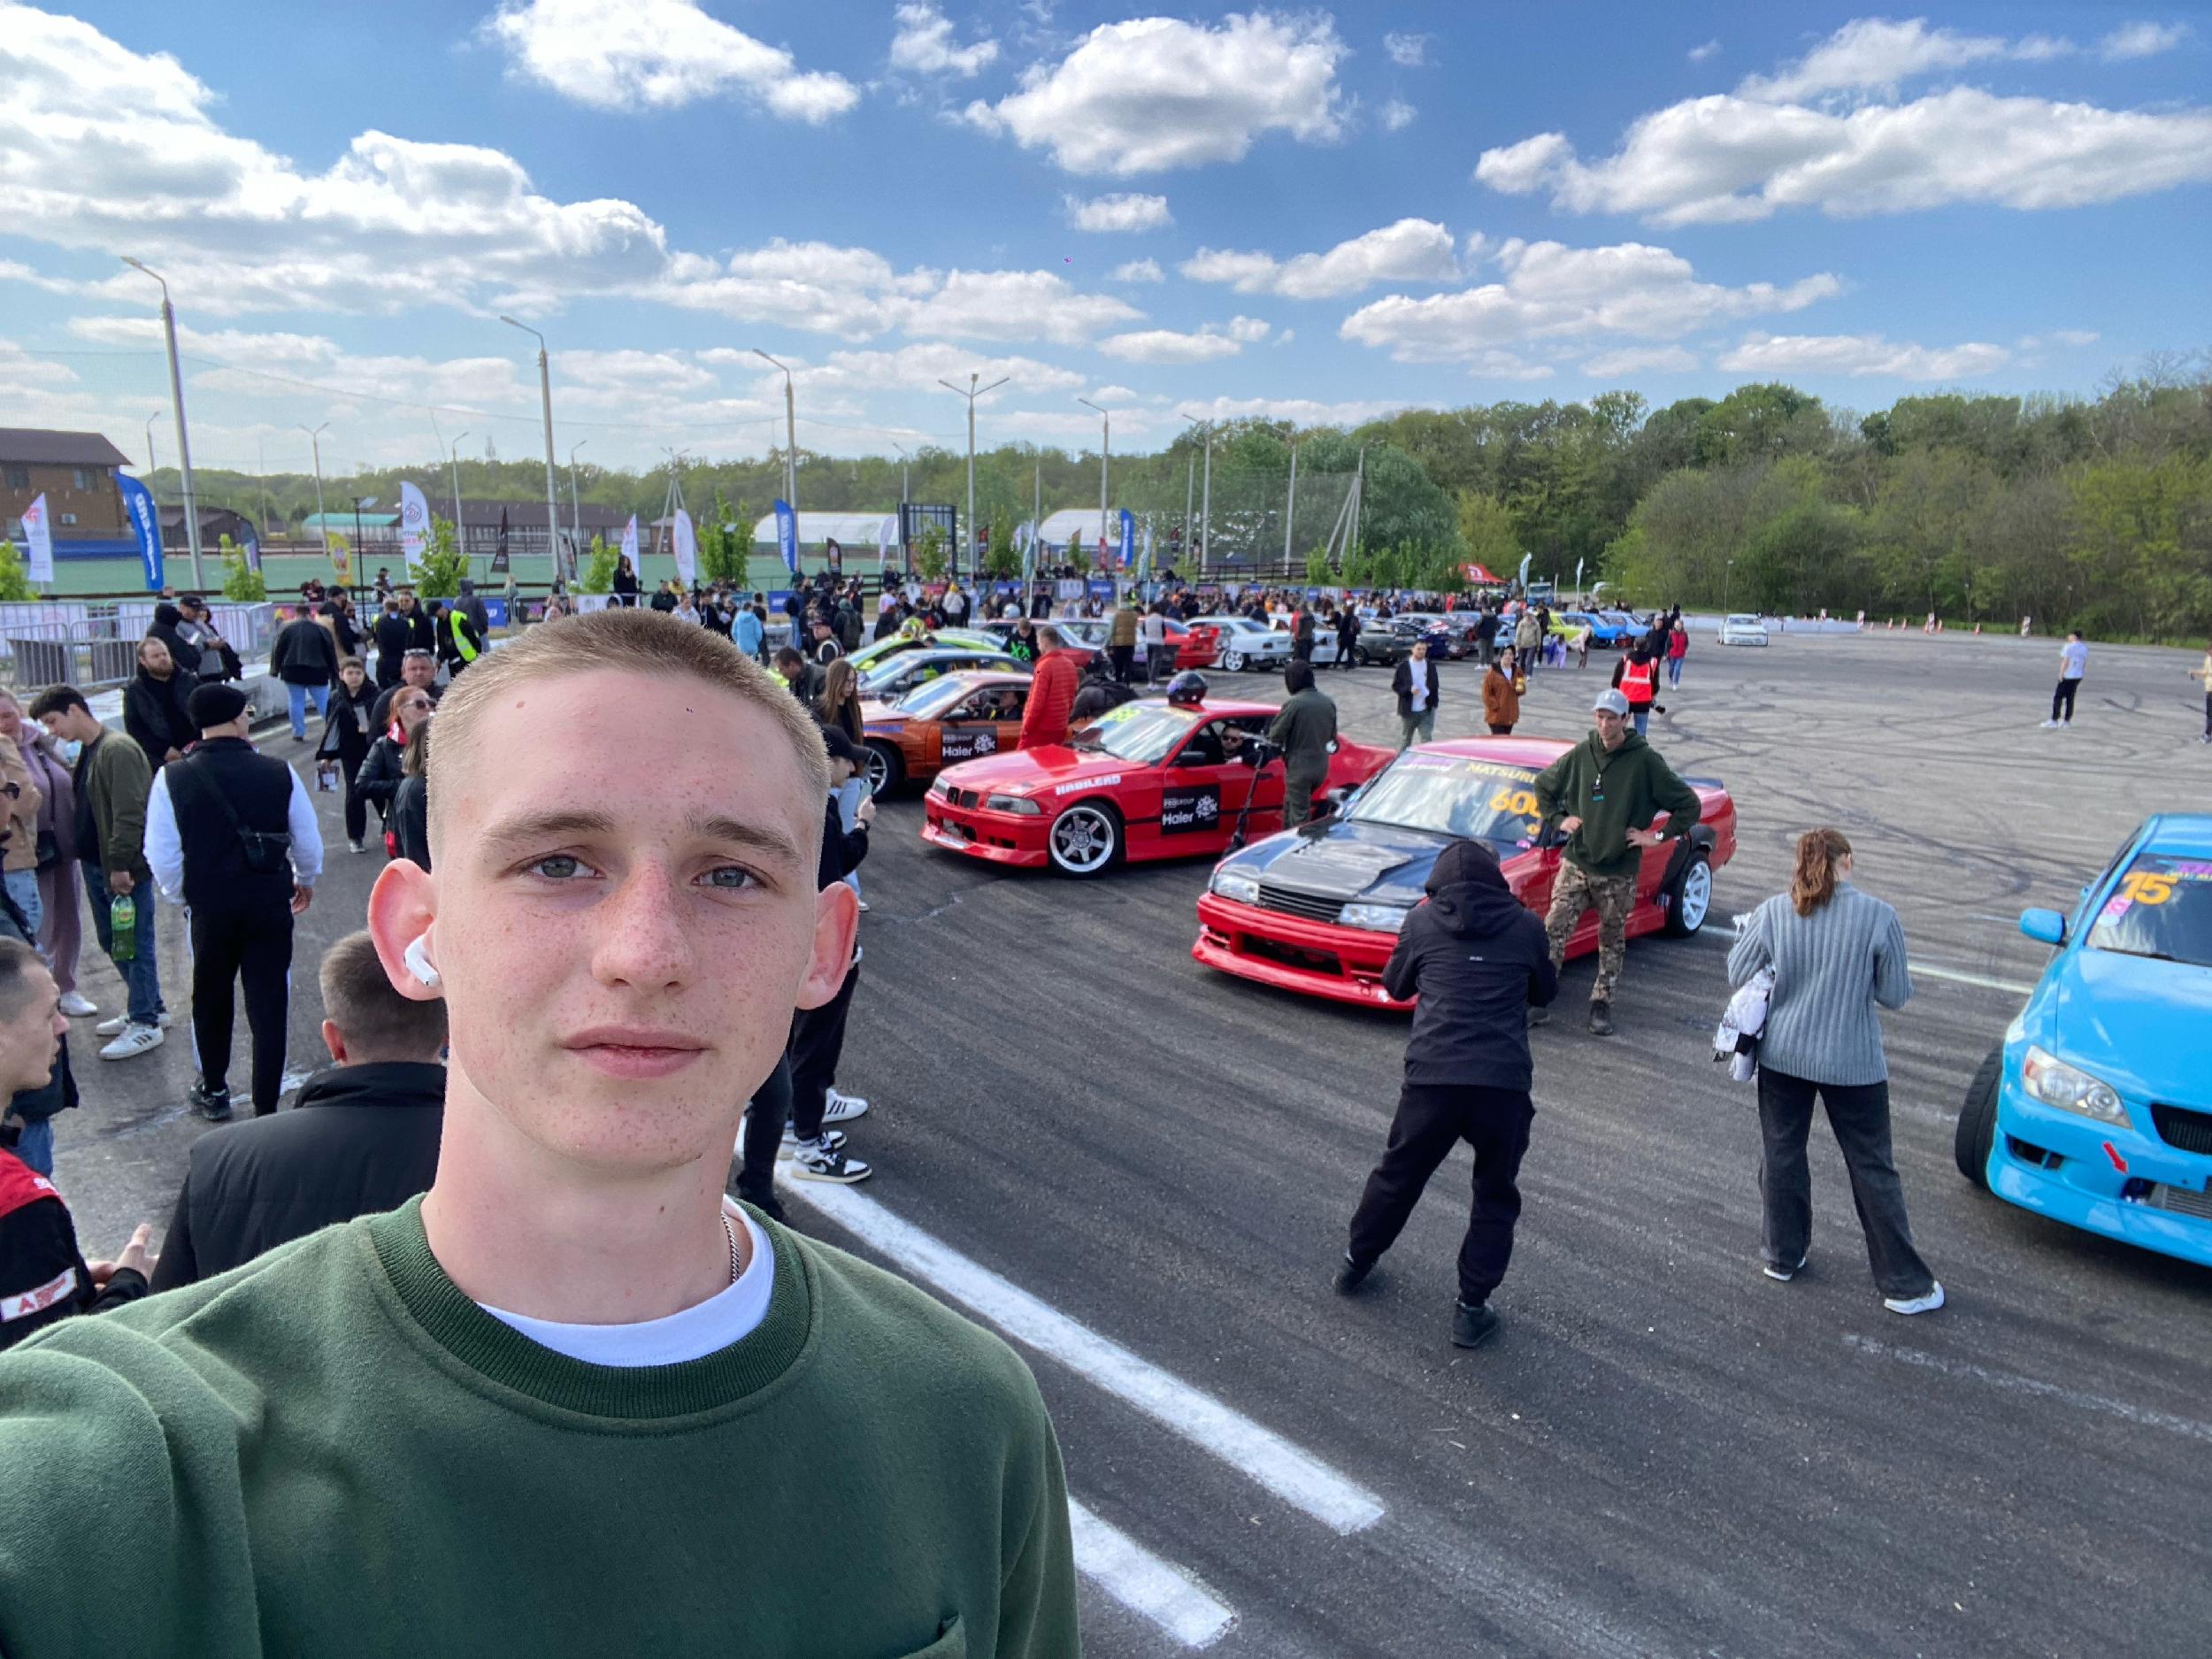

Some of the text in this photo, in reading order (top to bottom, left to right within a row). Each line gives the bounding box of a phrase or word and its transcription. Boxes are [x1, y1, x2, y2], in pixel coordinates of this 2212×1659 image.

[942, 745, 972, 757] Haier
[1163, 811, 1194, 826] Haier
[2123, 871, 2178, 905] 15
